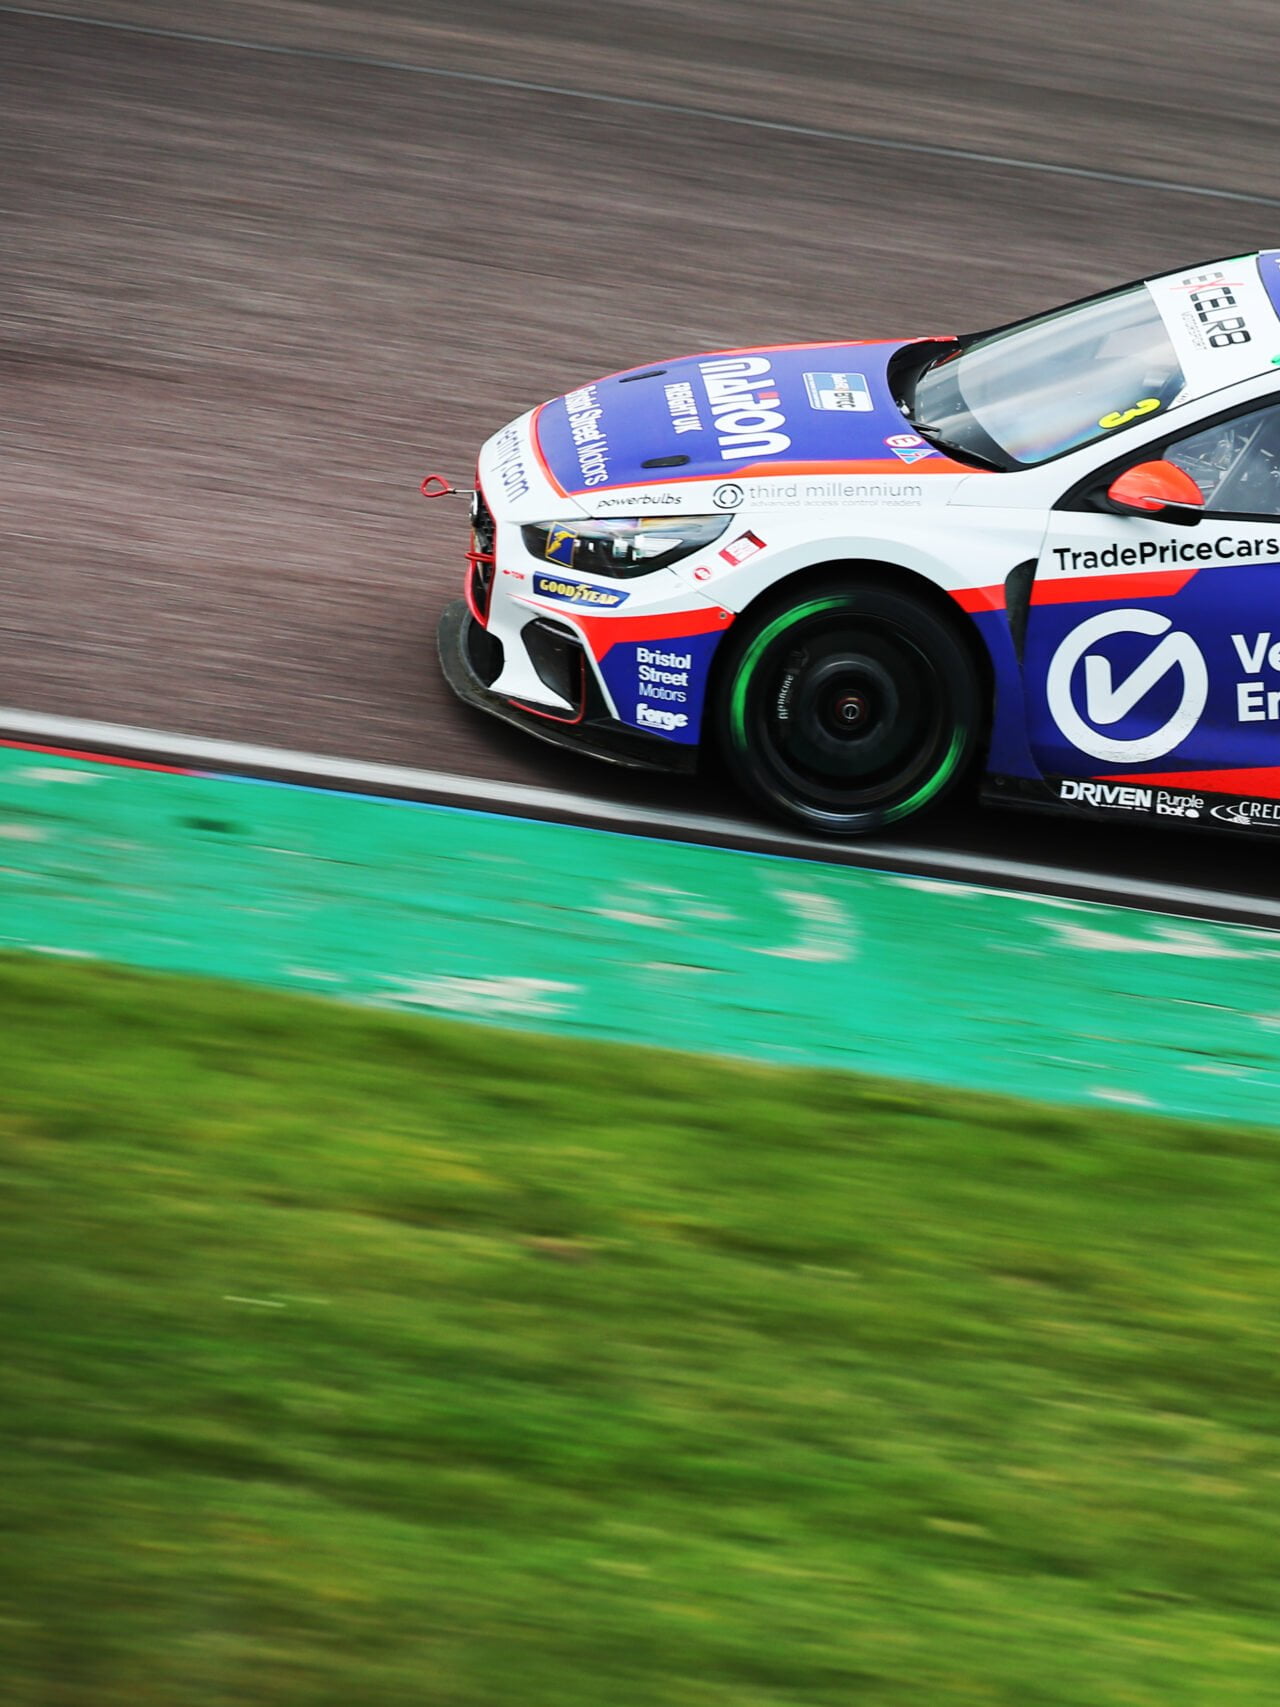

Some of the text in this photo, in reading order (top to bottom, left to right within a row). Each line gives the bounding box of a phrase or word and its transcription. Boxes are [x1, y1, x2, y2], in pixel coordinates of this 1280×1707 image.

[663, 382, 704, 434] FREIGHT UK
[1099, 398, 1162, 429] 3
[564, 384, 612, 486] Bristol Street Motors
[596, 492, 683, 509] powerbulbs
[750, 482, 923, 499] third millennium
[539, 579, 621, 605] GOODYEAR
[636, 647, 692, 669] Bristol
[638, 665, 689, 687] Street
[639, 682, 687, 702] Motors
[1060, 780, 1152, 807] DRIVEN
[1156, 791, 1204, 809] Purple
[1156, 804, 1186, 817] Dot
